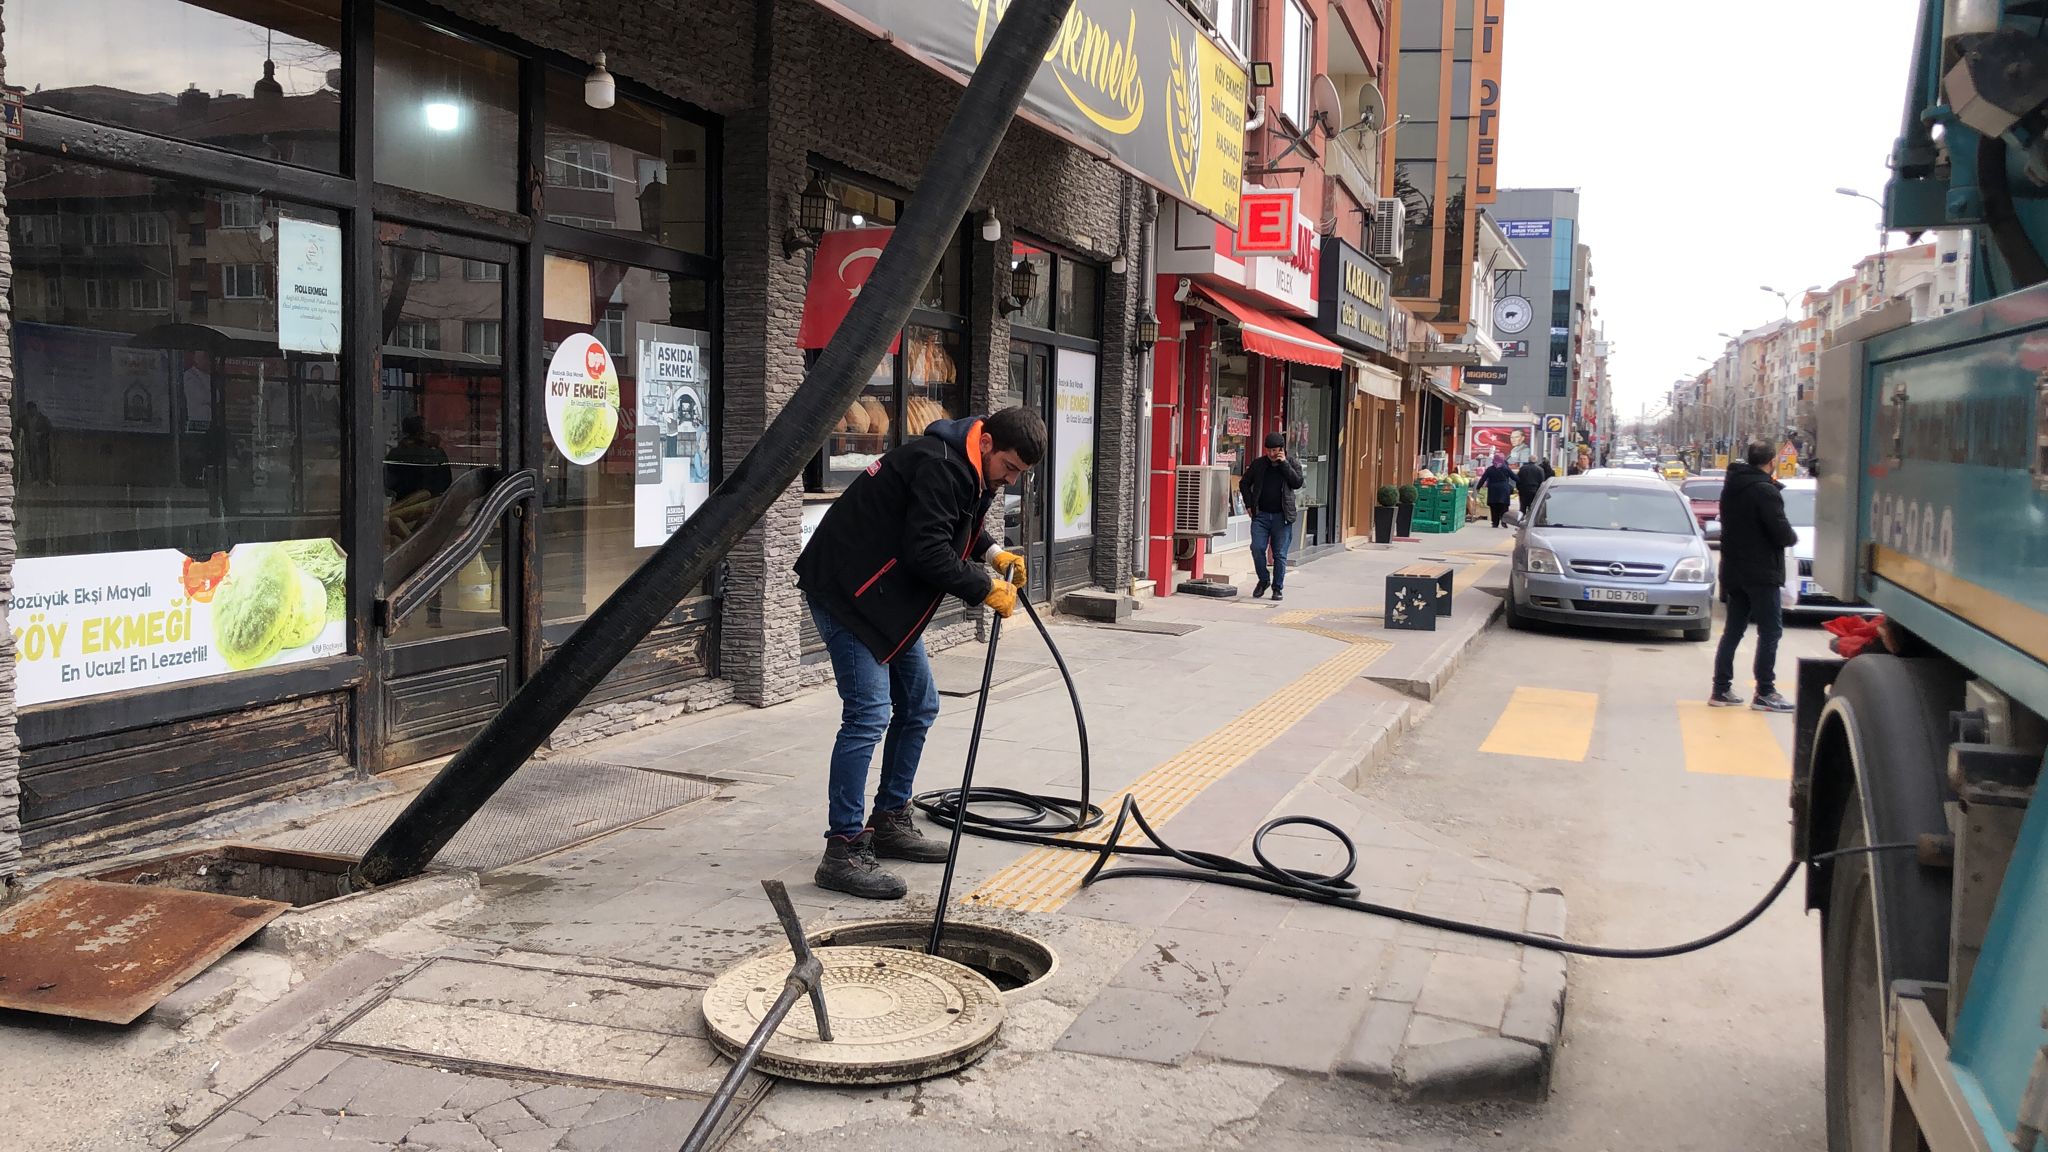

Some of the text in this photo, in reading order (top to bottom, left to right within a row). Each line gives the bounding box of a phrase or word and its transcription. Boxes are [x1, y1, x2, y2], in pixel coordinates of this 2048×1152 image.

[1043, 0, 1144, 116] kmek
[1211, 92, 1242, 131] SİMİT EKMEK
[1222, 168, 1239, 193] EKMEK
[1224, 200, 1237, 223] SİMİT
[1276, 268, 1294, 295] MELEK
[658, 346, 693, 364] ASKIDA
[659, 363, 692, 379] EKMEK
[551, 377, 607, 400] KÖY EKMEĞİ
[8, 583, 151, 611] Bozüyük Ekşi Mayalı
[1591, 589, 1600, 599] 11
[1625, 591, 1645, 602] 780
[82, 597, 192, 655] EKMEĞİ
[61, 647, 208, 683] En Ucuz! En Lezzetli!
